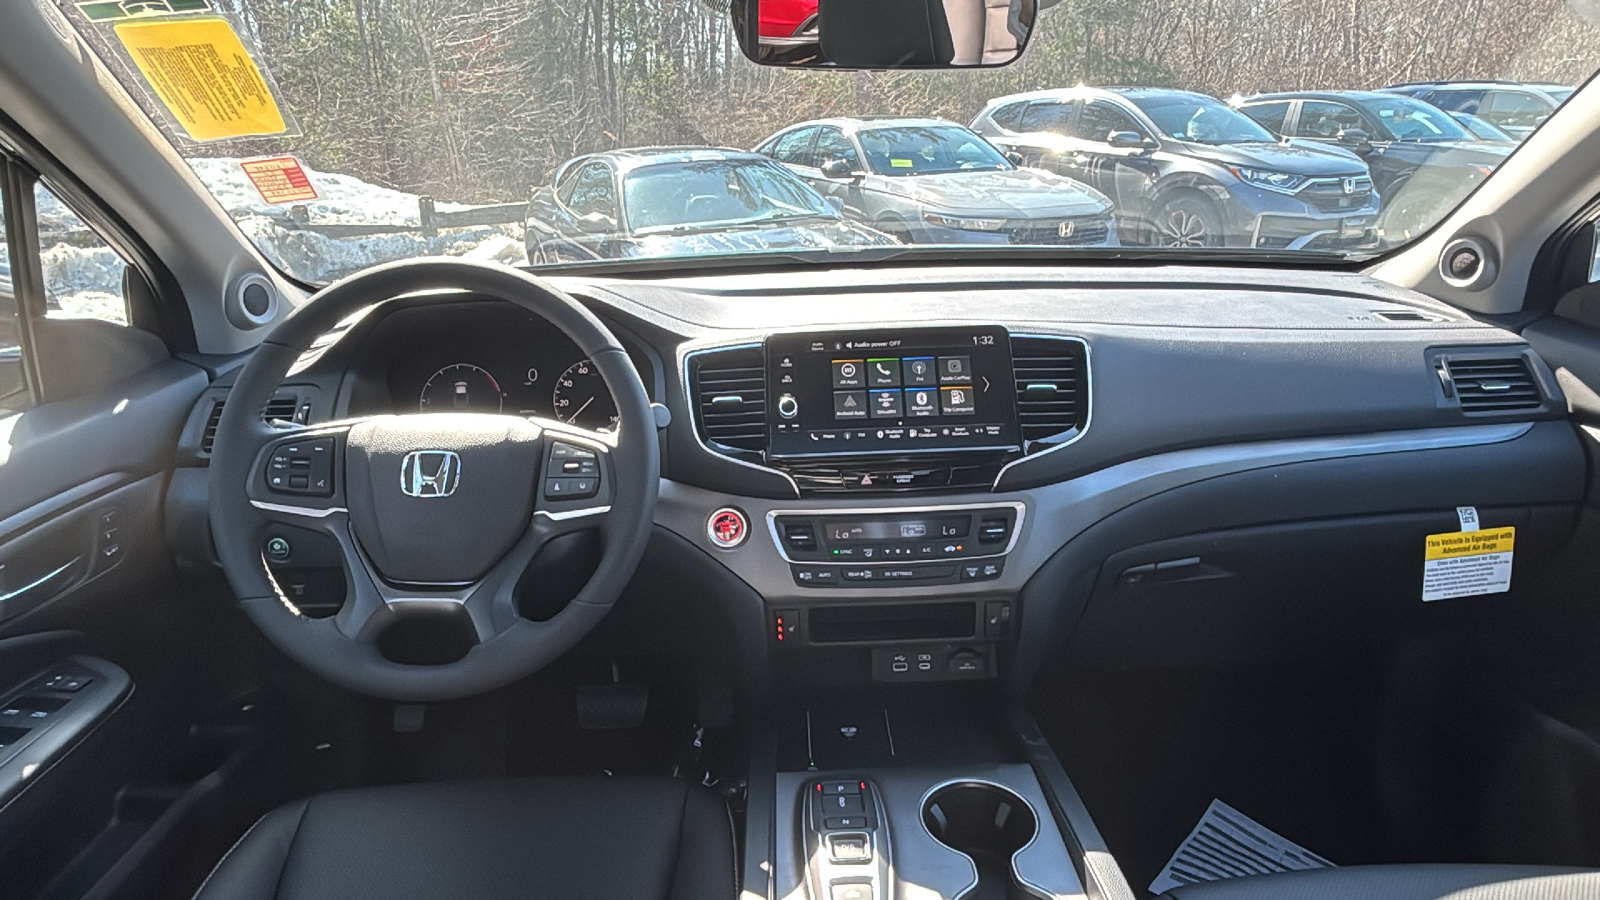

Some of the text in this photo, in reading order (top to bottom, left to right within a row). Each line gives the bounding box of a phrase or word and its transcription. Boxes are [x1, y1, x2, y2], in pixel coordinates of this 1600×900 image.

[972, 335, 994, 345] 1:32
[528, 368, 538, 382] 0
[560, 399, 569, 407] 20
[835, 529, 849, 539] Lo
[942, 526, 956, 535] Lo
[1441, 537, 1463, 546] Vehicle
[1472, 533, 1499, 542] Equipped
[1442, 546, 1471, 554] Advanced
